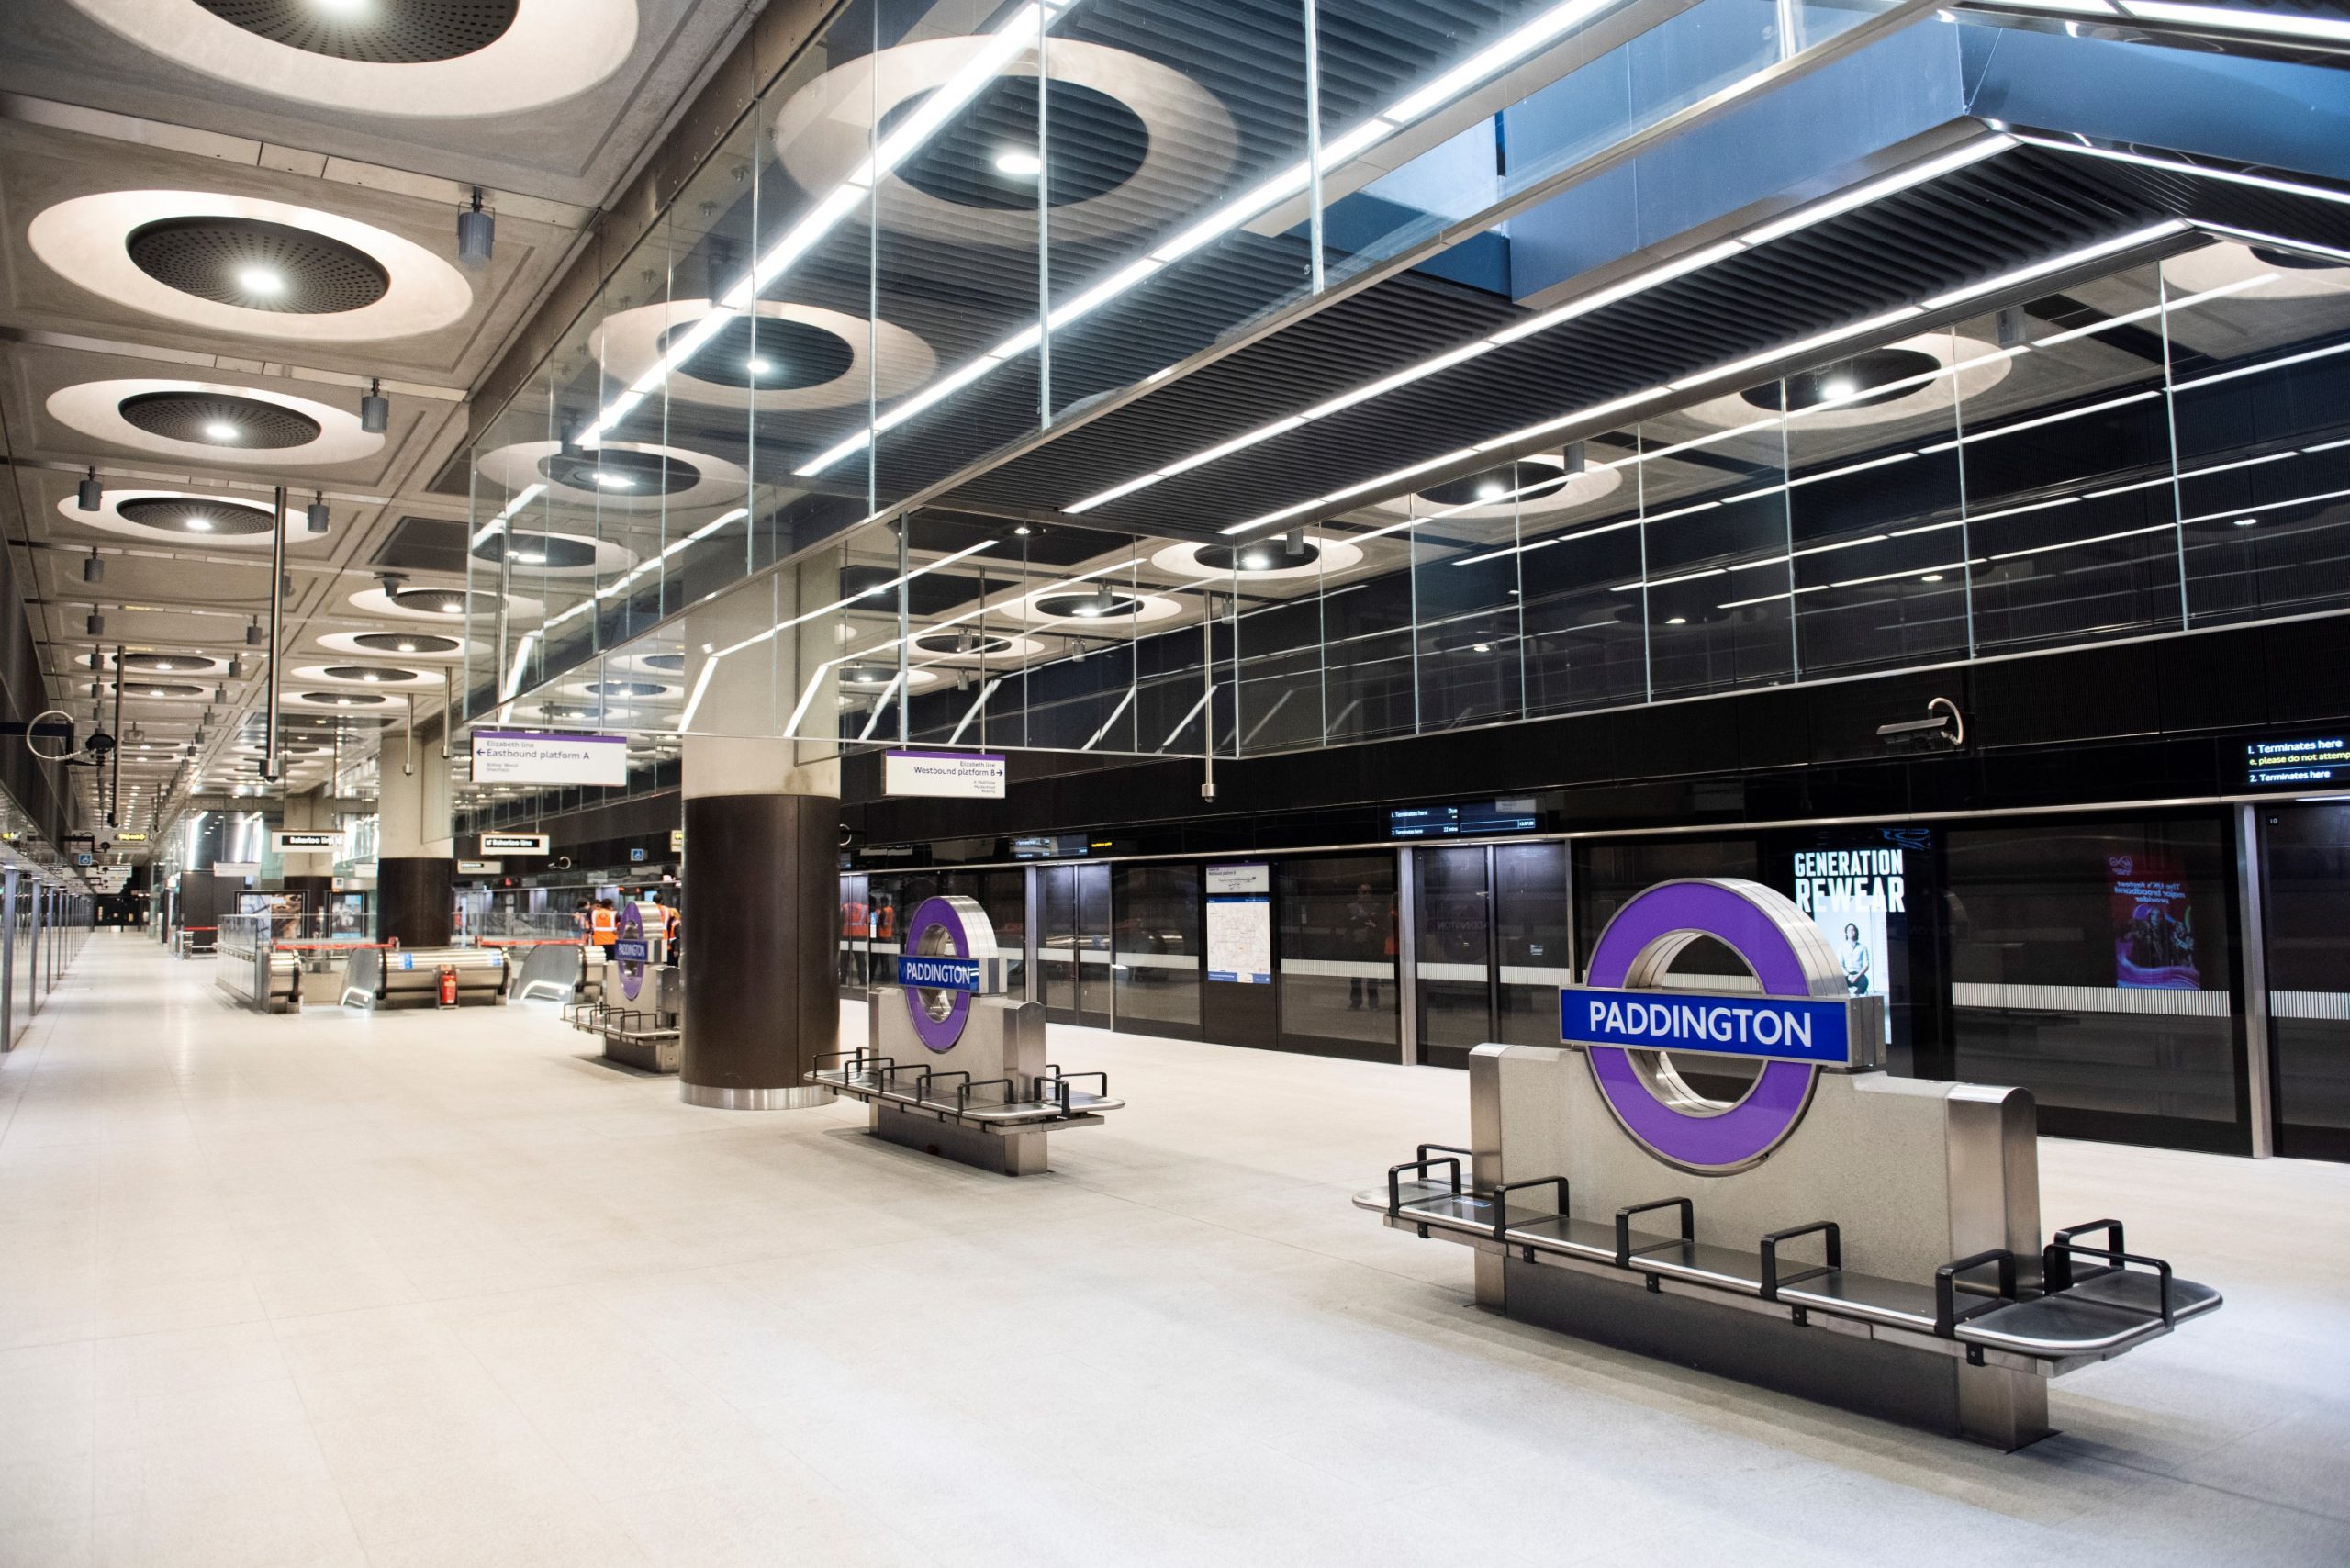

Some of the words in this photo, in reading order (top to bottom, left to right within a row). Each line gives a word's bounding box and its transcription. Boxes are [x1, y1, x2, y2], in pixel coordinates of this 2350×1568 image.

[487, 740, 520, 748] Elizabeth
[2257, 743, 2316, 753] Terminates
[2317, 740, 2343, 749] here
[487, 748, 537, 758] Eastbound
[540, 750, 580, 760] platform
[583, 752, 589, 760] A
[2258, 757, 2287, 766] please
[2288, 755, 2300, 763] do
[2319, 751, 2350, 760] attemp
[914, 767, 956, 775] Westbound
[957, 768, 989, 777] platform
[2259, 771, 2309, 781] Terminates
[2309, 770, 2331, 778] here
[1794, 849, 1904, 878] GENERATION
[1796, 876, 1906, 913] REWEAR
[618, 943, 645, 957] PADDINGTON
[906, 962, 970, 985] PADDINGTON
[1589, 1001, 1812, 1047] PADDINGTON
